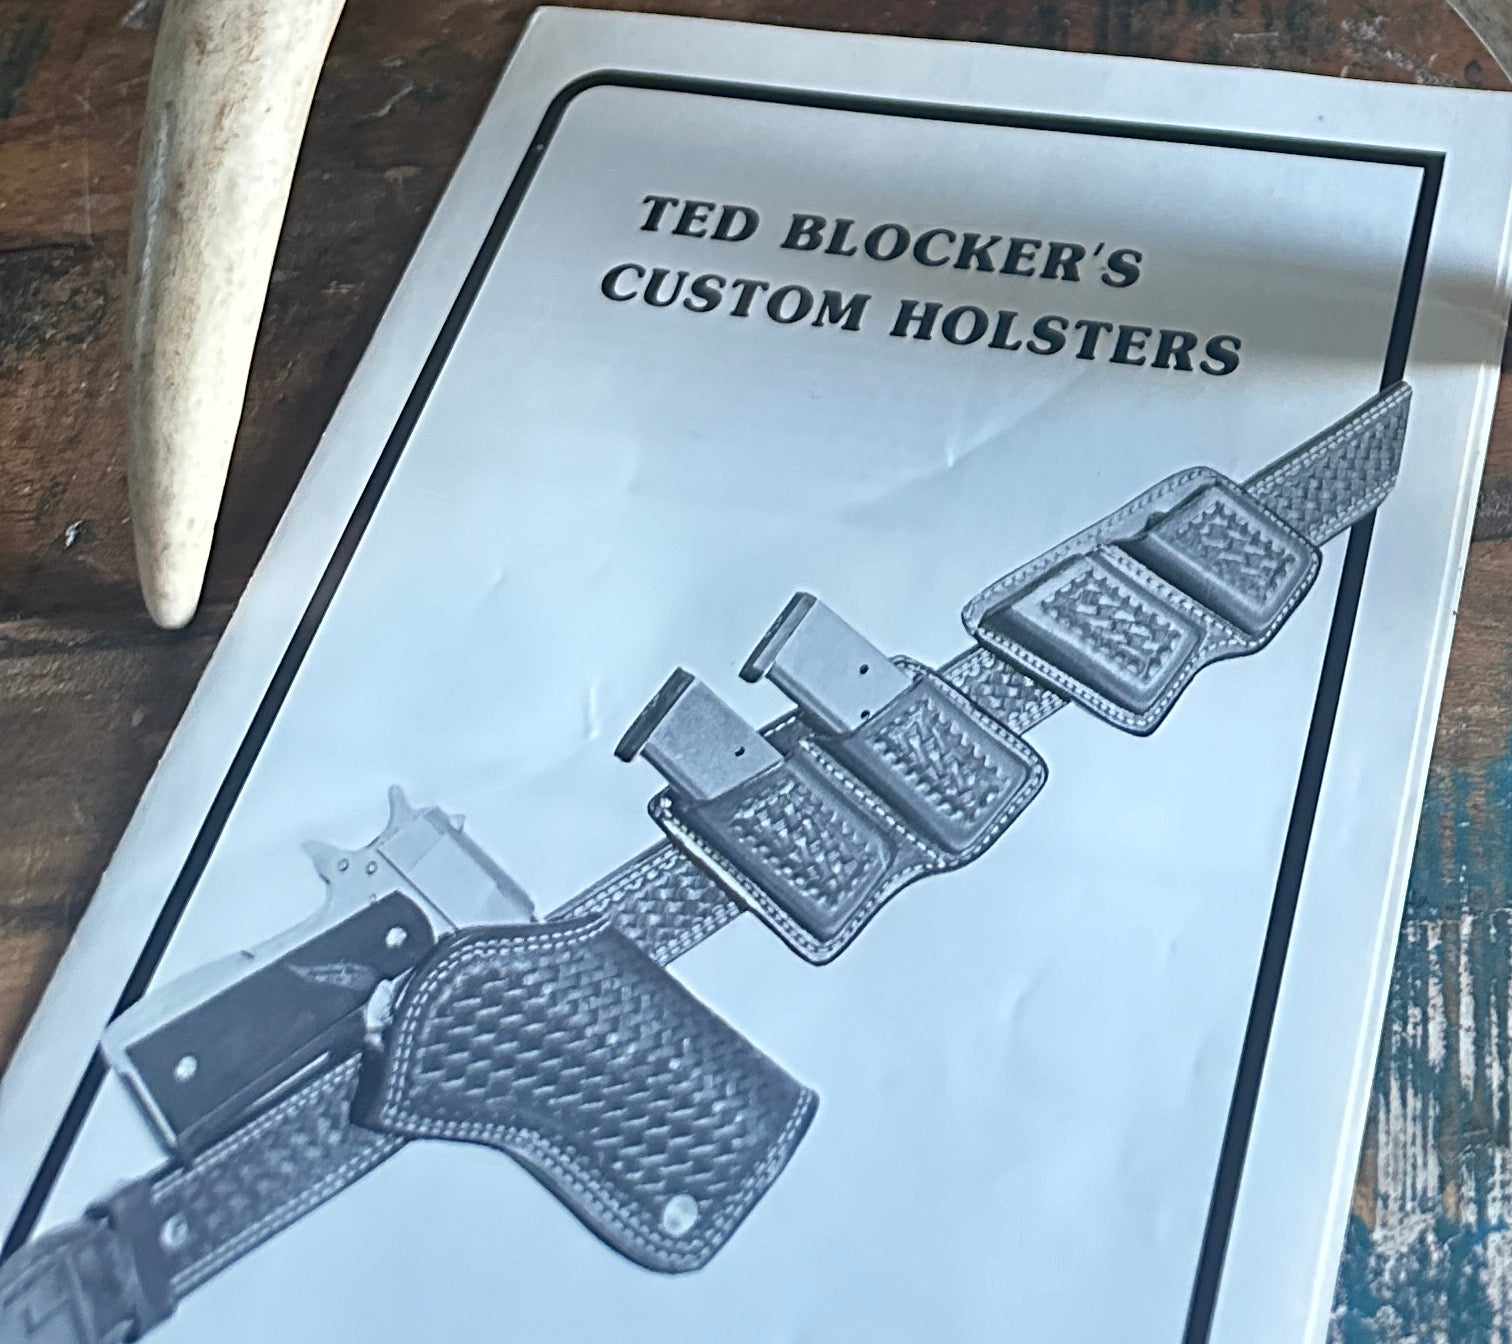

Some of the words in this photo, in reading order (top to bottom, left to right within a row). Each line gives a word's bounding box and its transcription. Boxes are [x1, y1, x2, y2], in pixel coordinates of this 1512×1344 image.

[639, 194, 760, 244] TED
[781, 213, 1144, 289] BLOCKER'S
[600, 263, 872, 332] CUSTOM
[889, 299, 1243, 377] HOLSTERS
